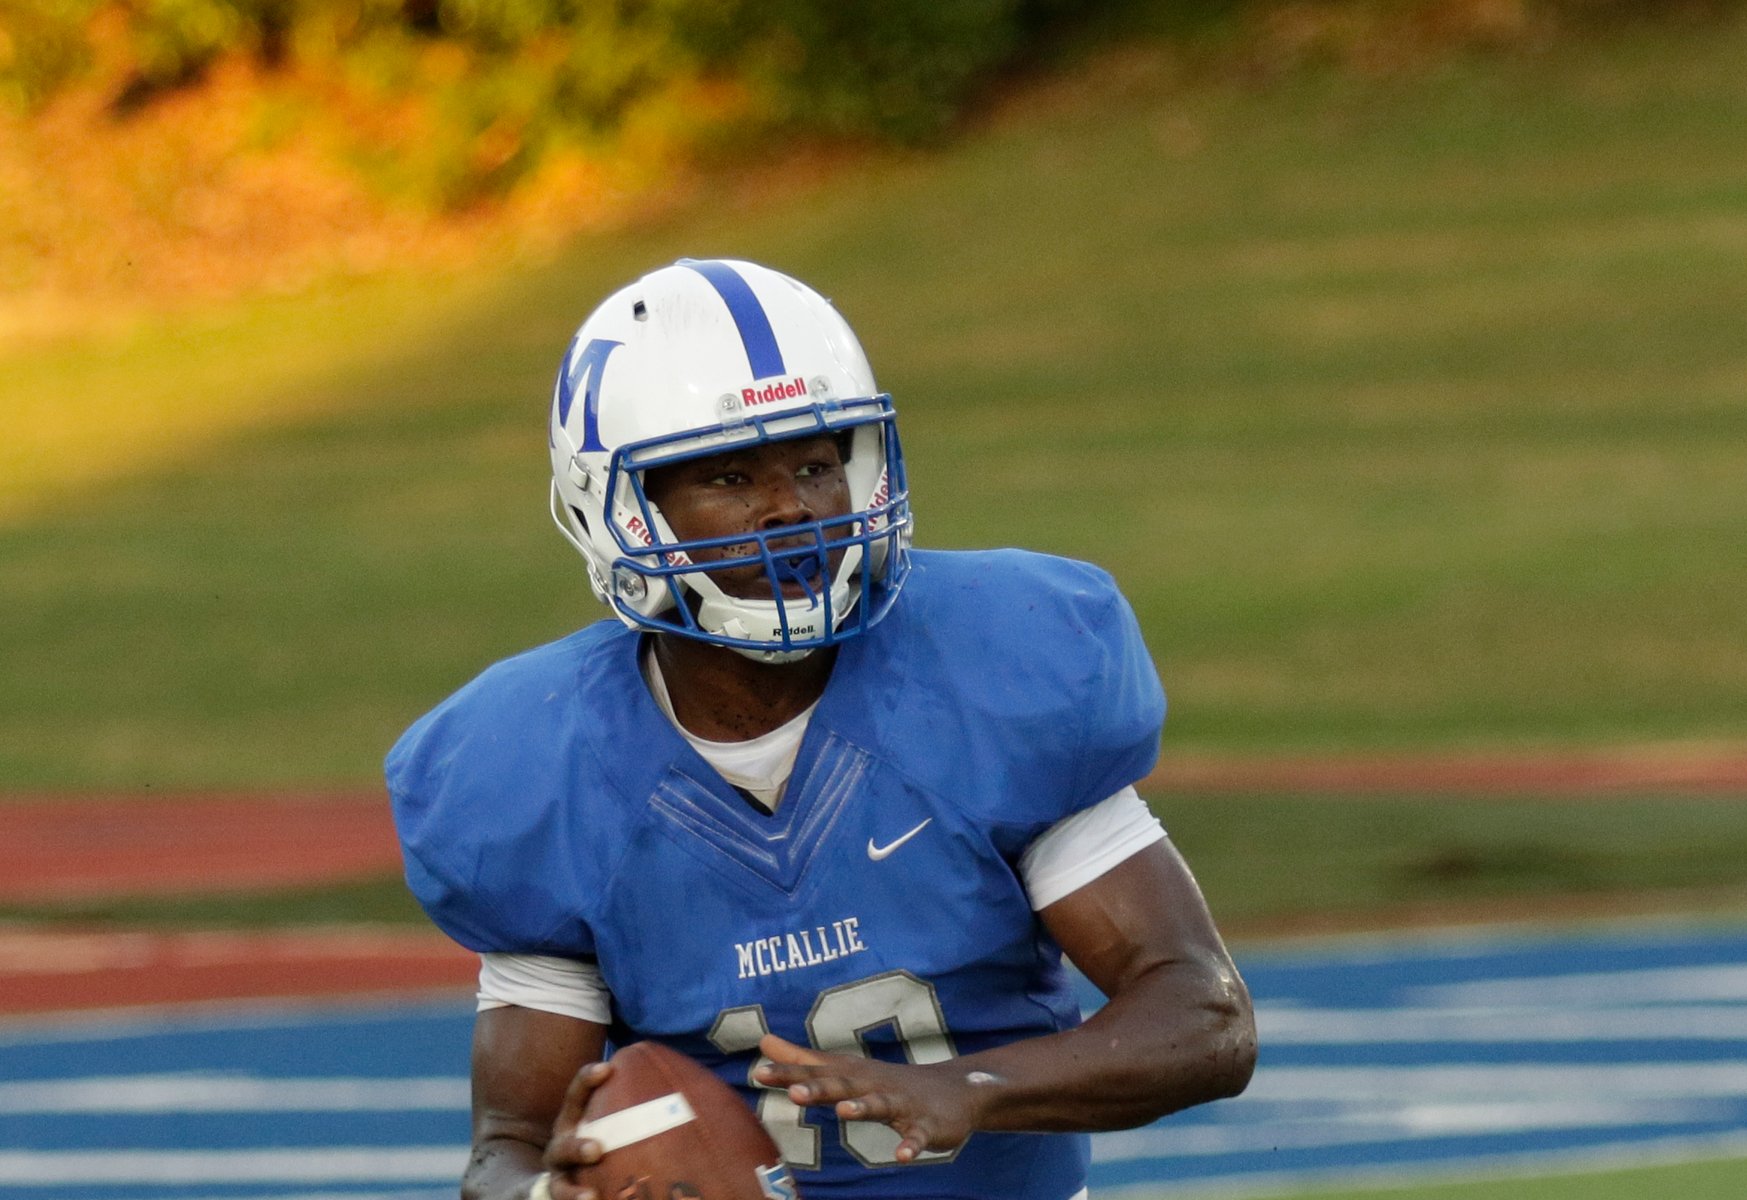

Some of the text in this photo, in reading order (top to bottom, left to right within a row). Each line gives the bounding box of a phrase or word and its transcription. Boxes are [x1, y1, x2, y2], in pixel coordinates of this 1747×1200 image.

[549, 336, 625, 453] M
[742, 377, 807, 407] Riddell
[626, 516, 692, 577] Ridell
[773, 625, 814, 636] Rddell
[735, 917, 866, 979] MCCALLIE
[707, 969, 973, 1171] 10
